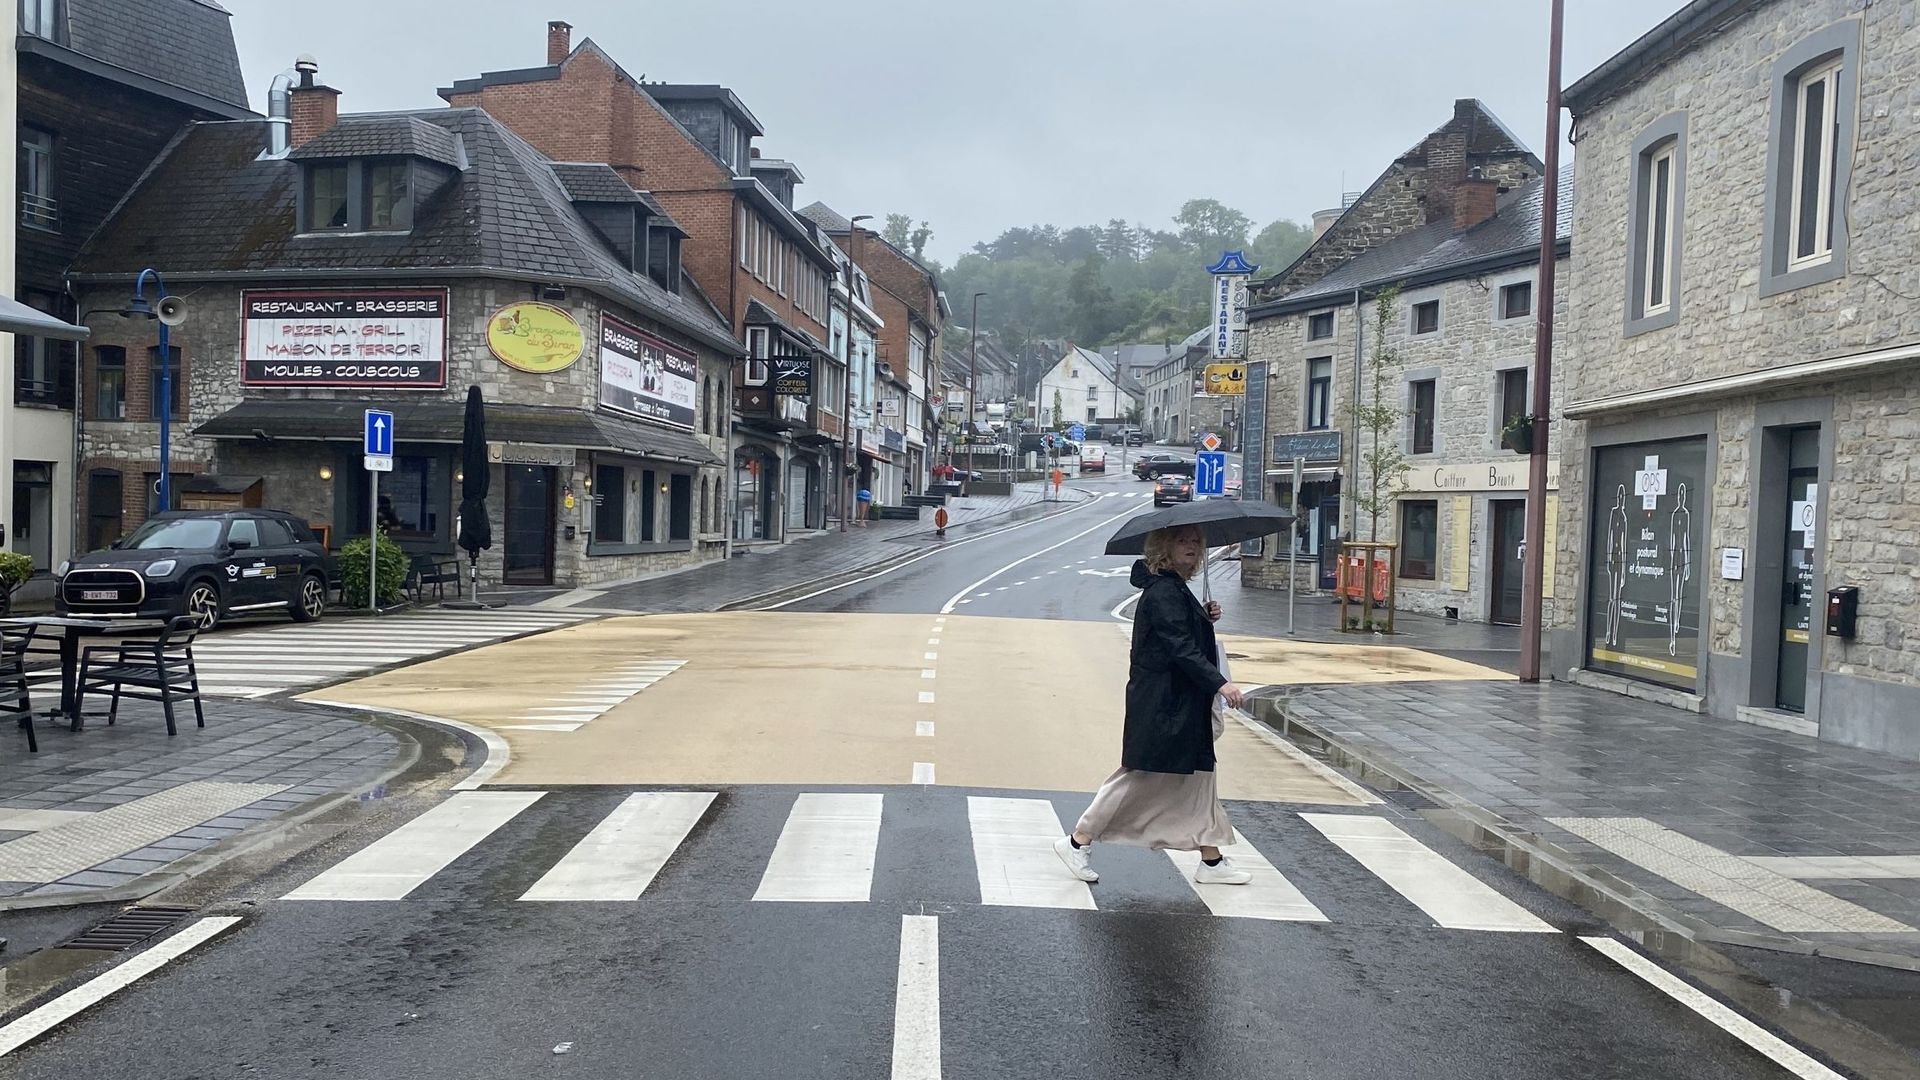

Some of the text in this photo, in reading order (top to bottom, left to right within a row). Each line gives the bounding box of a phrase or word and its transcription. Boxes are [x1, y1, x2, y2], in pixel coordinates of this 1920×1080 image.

[252, 301, 343, 313] RESTAURANT
[355, 301, 438, 312] BRASSERIE
[1218, 280, 1229, 356] RESTAURANT
[282, 325, 347, 337] PIZZERIA
[361, 324, 405, 337] GRILL
[514, 317, 581, 337] Brasserie
[526, 334, 540, 346] du
[266, 344, 422, 356] MAISON DE TERROIR
[264, 366, 323, 377] MOULES
[335, 366, 420, 377] COUSCOUS
[665, 353, 696, 375] RESTAURANT
[1434, 467, 1467, 488] Coiffure
[1641, 472, 1660, 493] OPS
[1641, 527, 1655, 541] Bilan
[1636, 545, 1658, 560] postural
[1629, 562, 1664, 579] et dynamique
